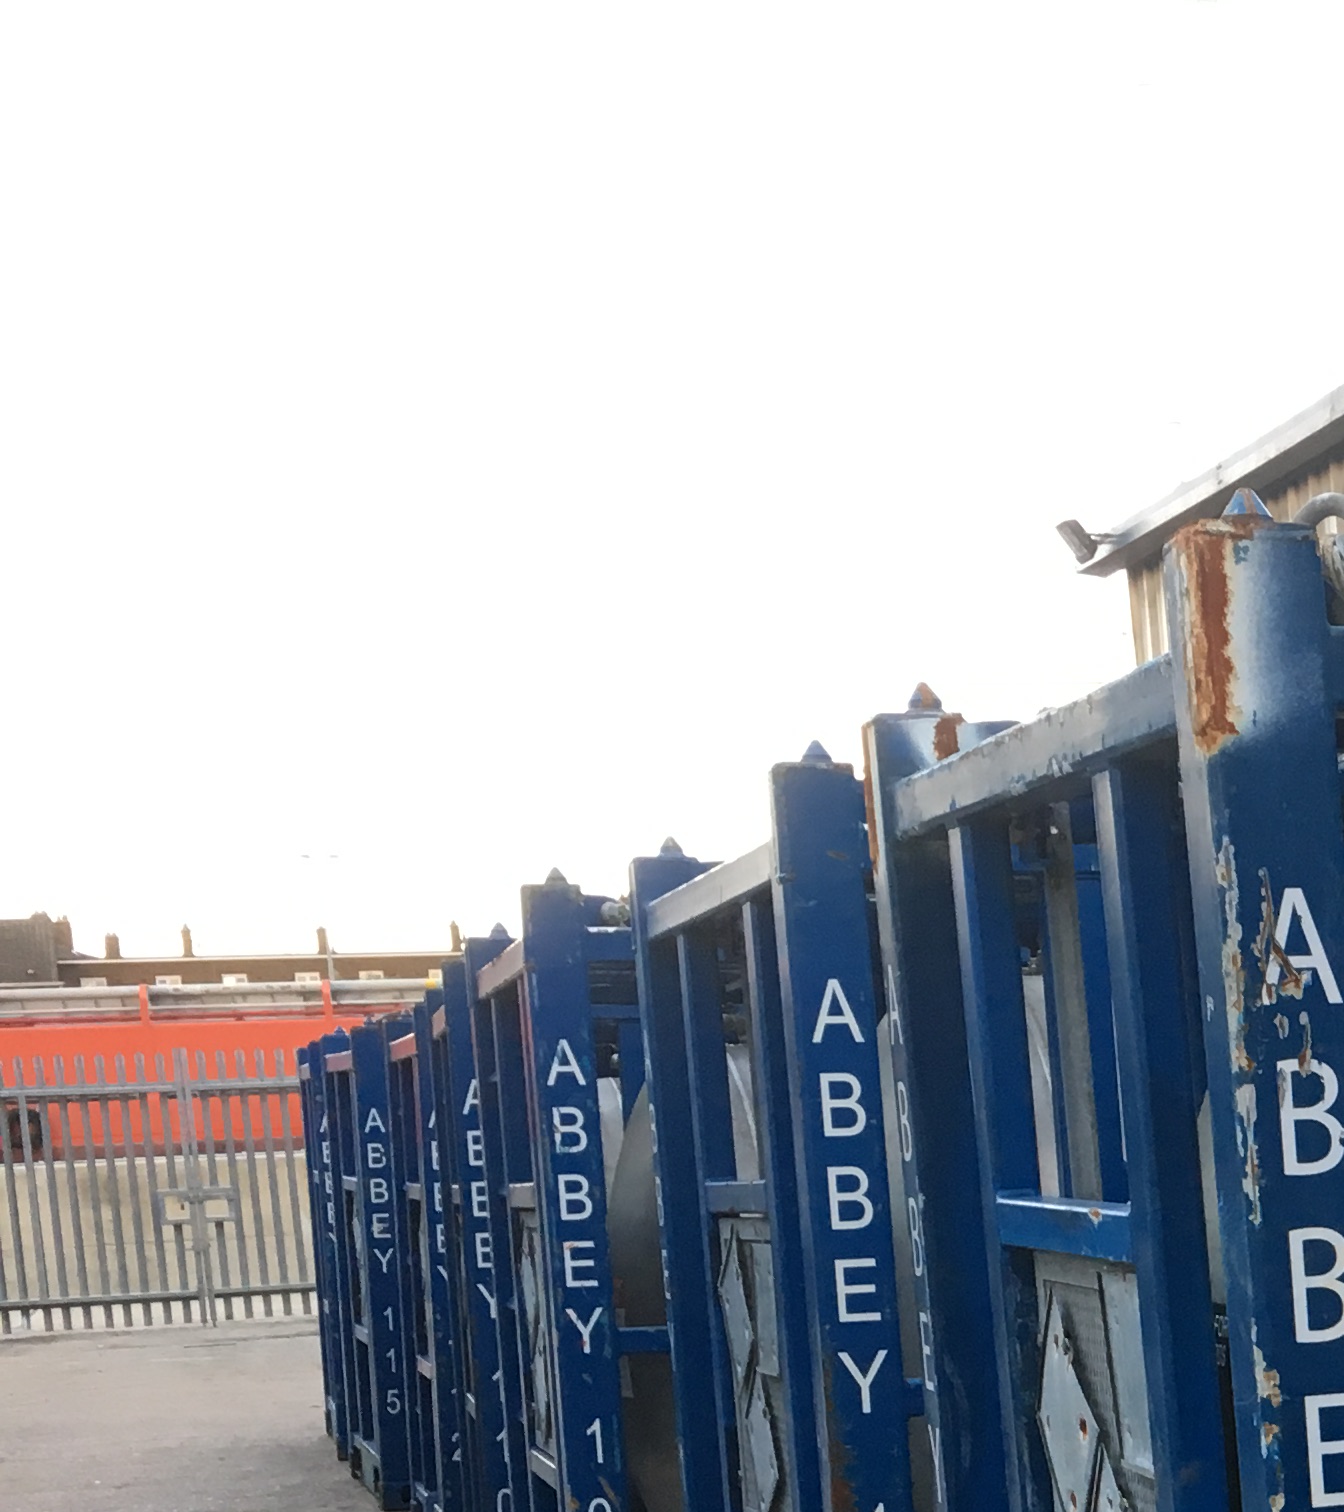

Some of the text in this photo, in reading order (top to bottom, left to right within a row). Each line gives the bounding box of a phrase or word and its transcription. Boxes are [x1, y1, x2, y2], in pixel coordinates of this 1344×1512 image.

[364, 1107, 401, 1415] ABBEY 115
[547, 1038, 603, 1355] ABBEY
[811, 977, 889, 1415] ABBEY
[886, 964, 946, 1504] ABBEY
